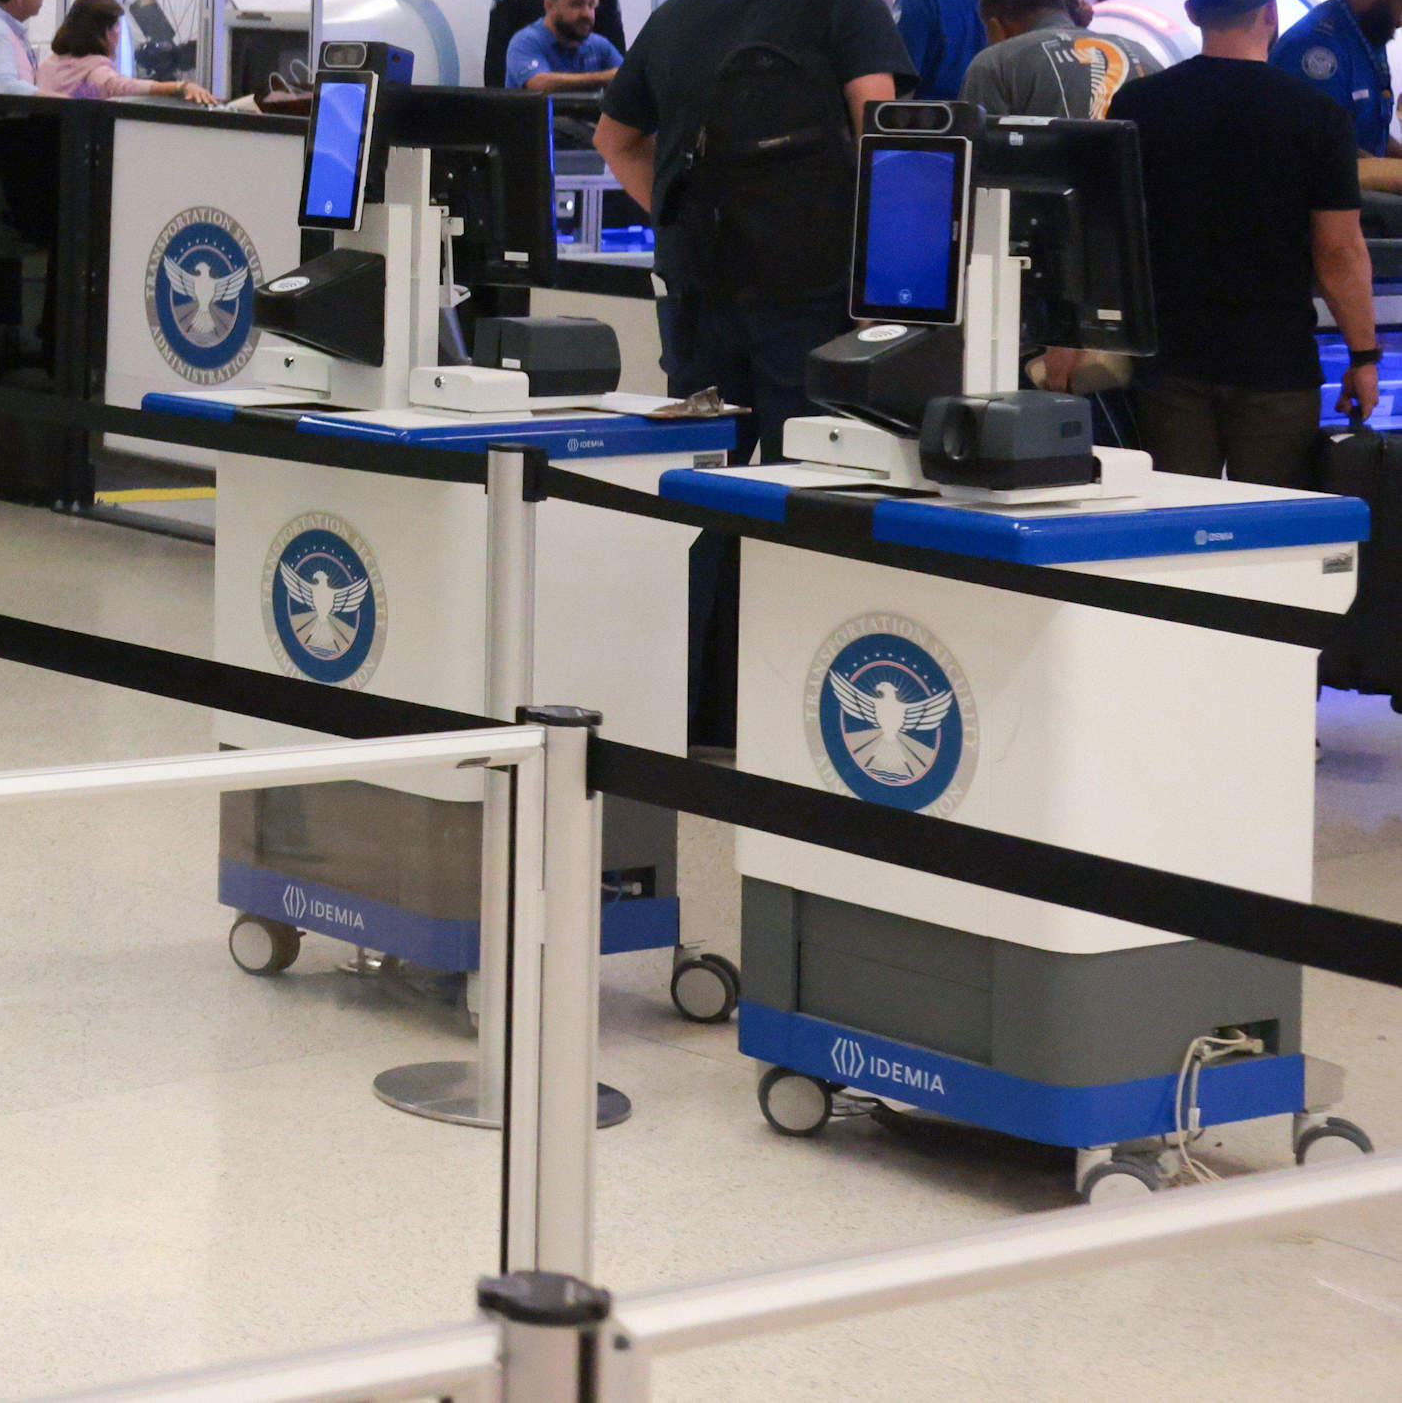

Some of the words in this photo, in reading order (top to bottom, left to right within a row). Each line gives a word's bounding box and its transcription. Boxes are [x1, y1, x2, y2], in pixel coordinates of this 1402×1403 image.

[145, 208, 232, 298] TRANSPORTATION
[151, 325, 256, 385] ADMINISTRATION
[309, 901, 365, 931] IDEMIA
[869, 1055, 946, 1096] IDEMIA
